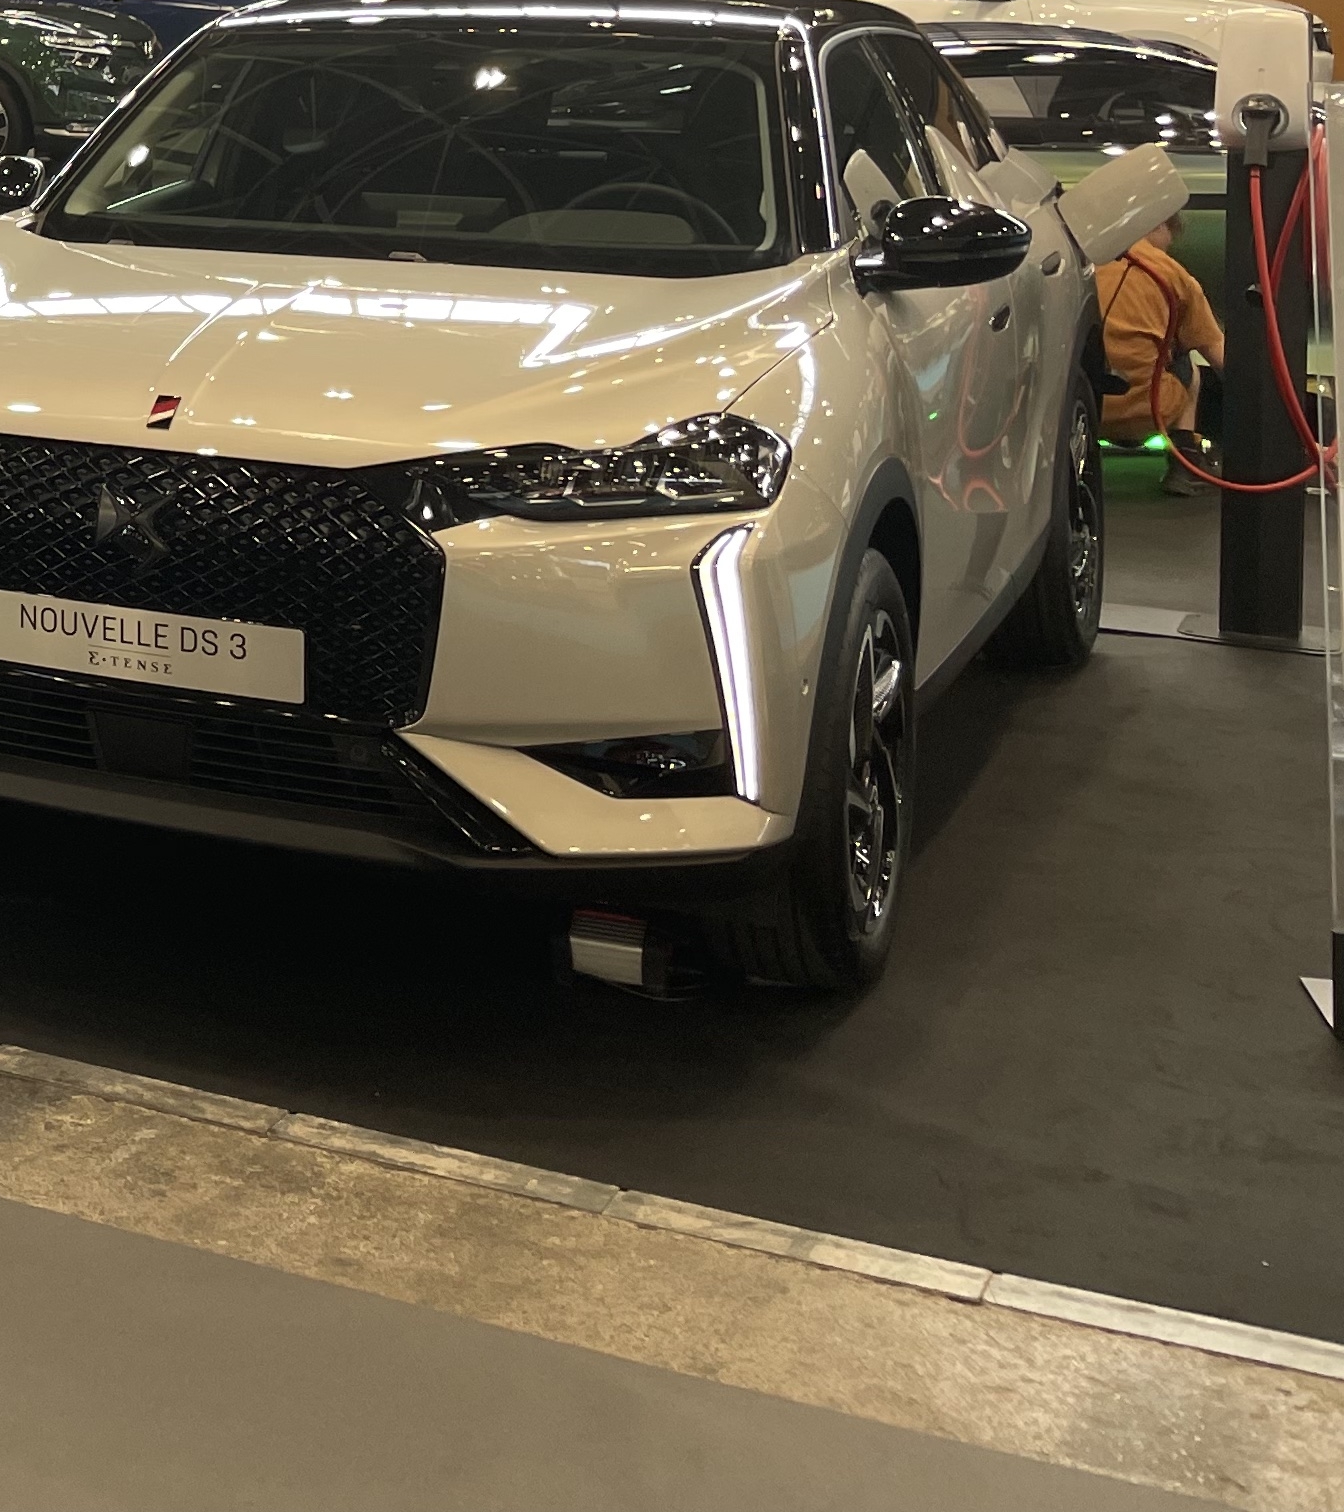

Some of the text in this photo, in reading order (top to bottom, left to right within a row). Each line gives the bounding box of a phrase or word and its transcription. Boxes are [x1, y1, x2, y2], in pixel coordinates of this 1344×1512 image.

[19, 603, 247, 660] NOUVELLE DS 3
